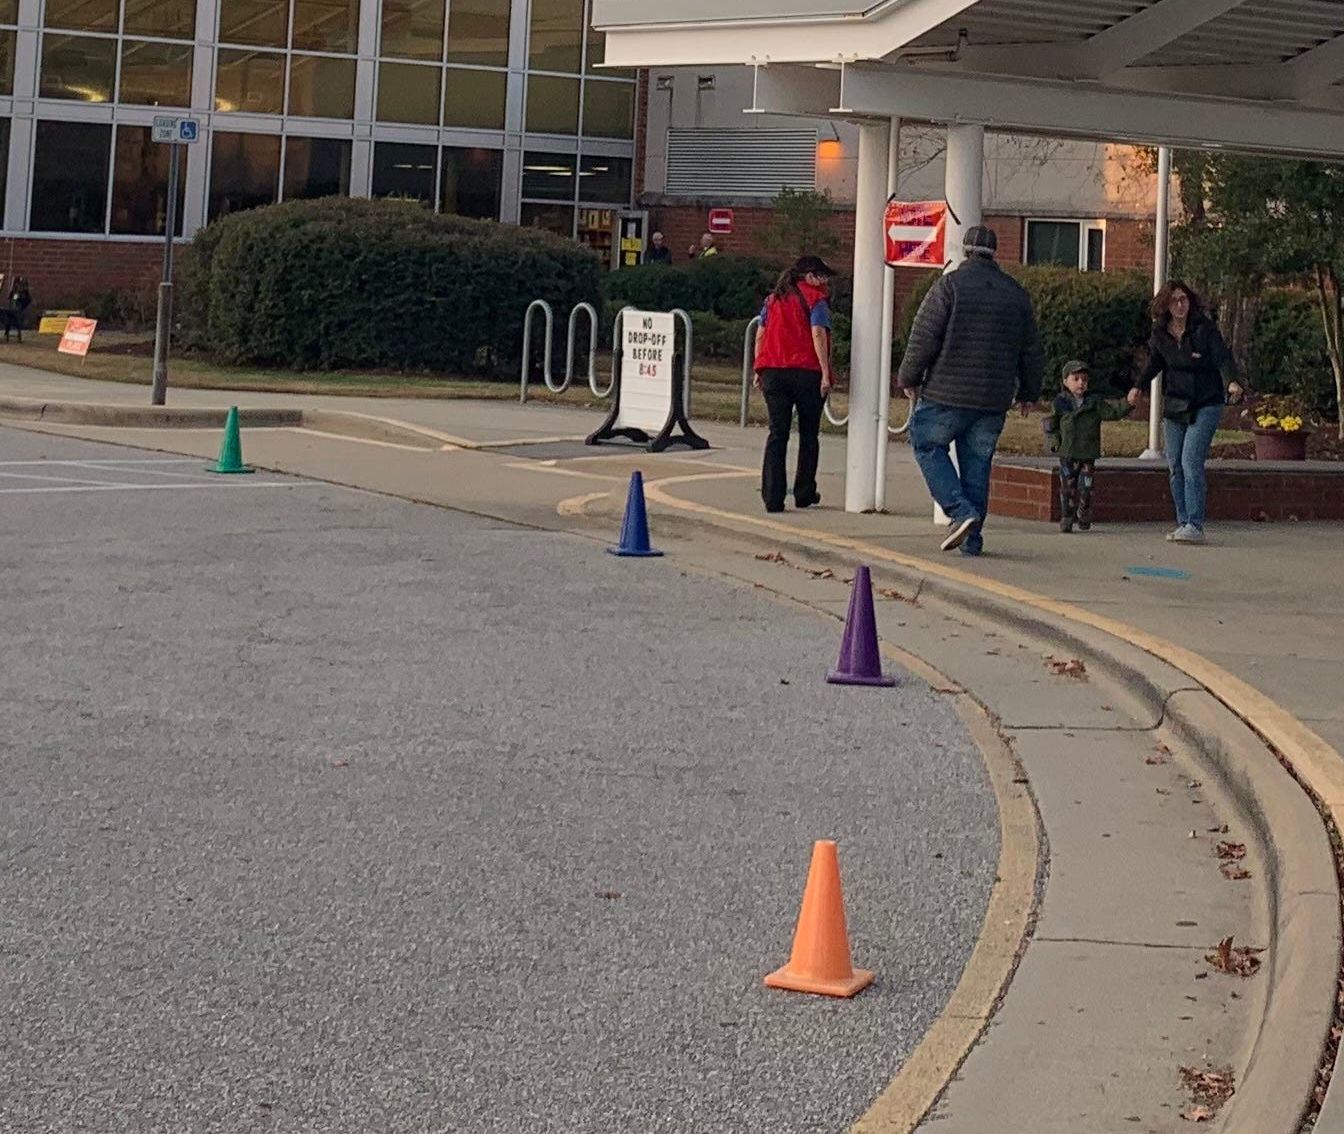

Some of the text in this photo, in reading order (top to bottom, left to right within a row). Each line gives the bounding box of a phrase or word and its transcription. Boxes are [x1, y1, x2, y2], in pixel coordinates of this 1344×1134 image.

[642, 317, 653, 329] NO
[628, 331, 666, 346] DROP-OFF
[632, 348, 662, 362] BEFORE
